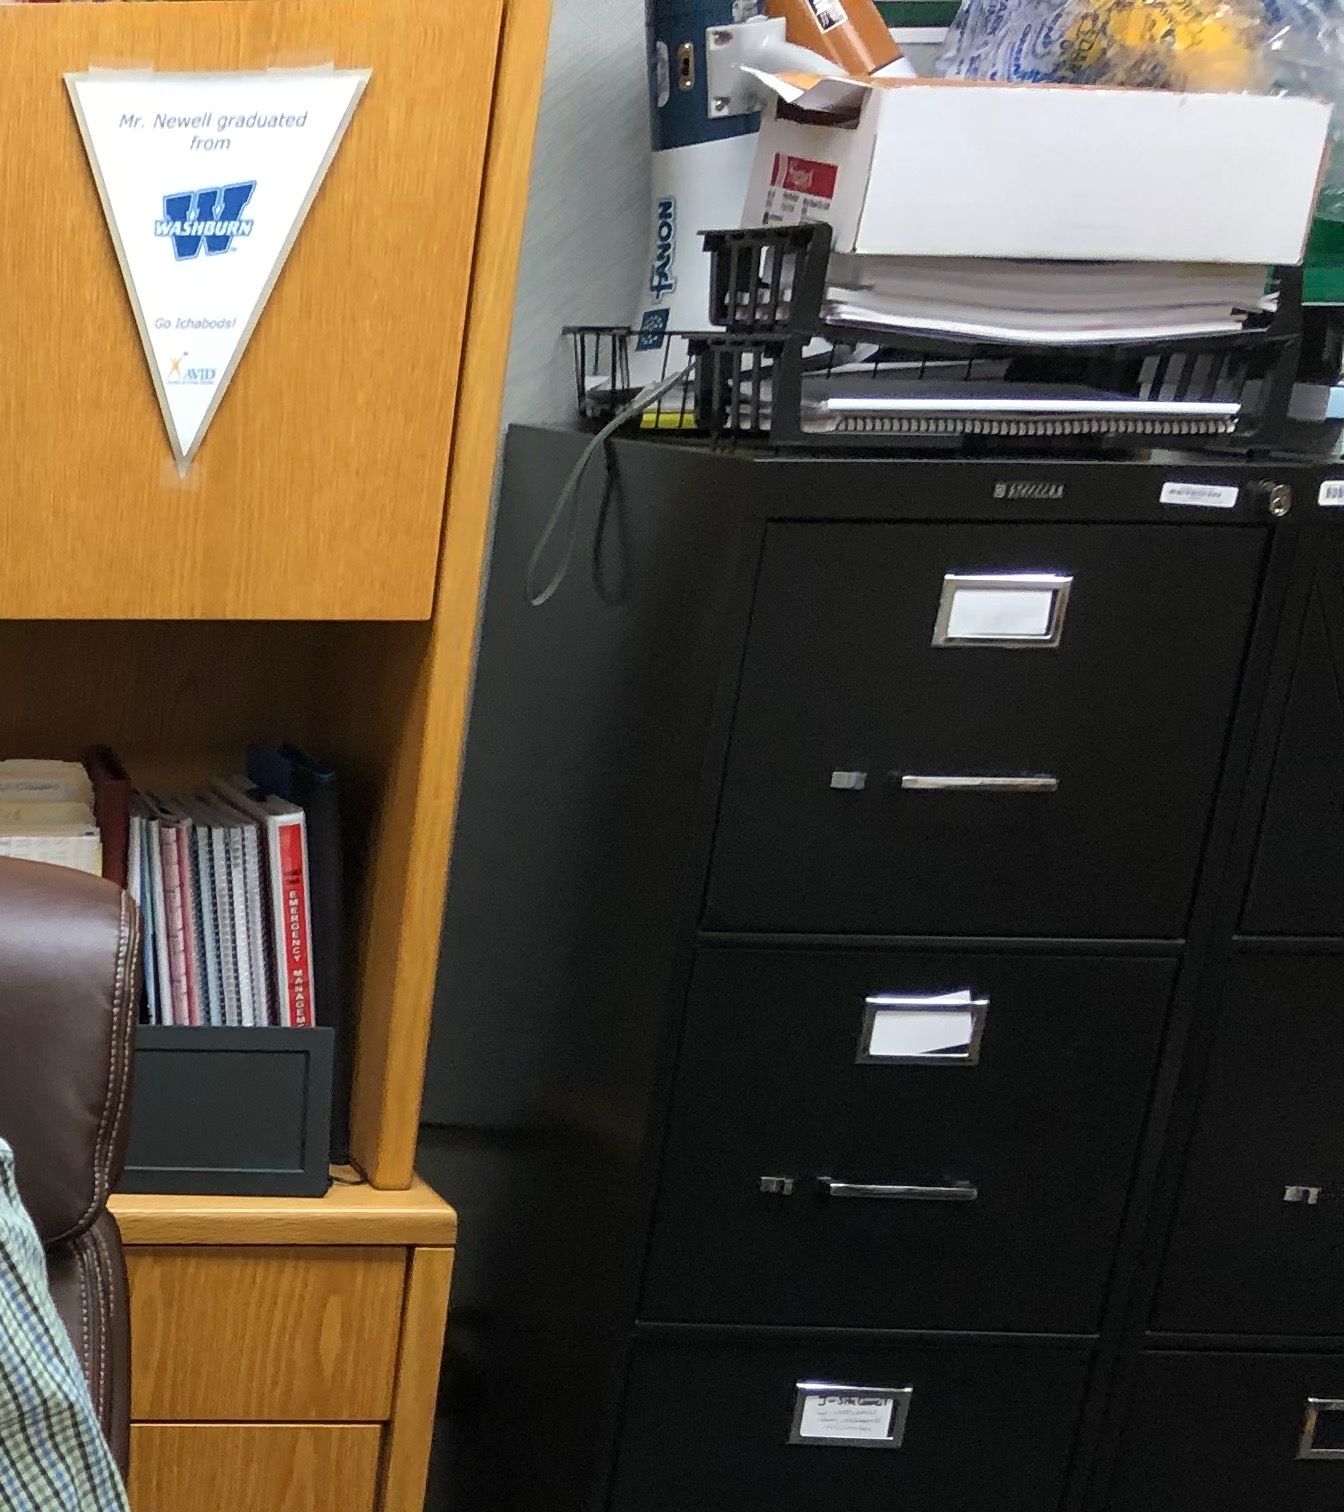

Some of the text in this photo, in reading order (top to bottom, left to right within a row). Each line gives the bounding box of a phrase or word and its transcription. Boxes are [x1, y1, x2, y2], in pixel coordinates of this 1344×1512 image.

[118, 111, 309, 132] Mr. Newell graduated
[189, 135, 231, 151] from
[154, 219, 254, 237] WASHBURN
[155, 317, 237, 330] Go Ichabods!
[289, 890, 301, 962] EMERGENCY
[293, 969, 306, 1027] MANAGEM
